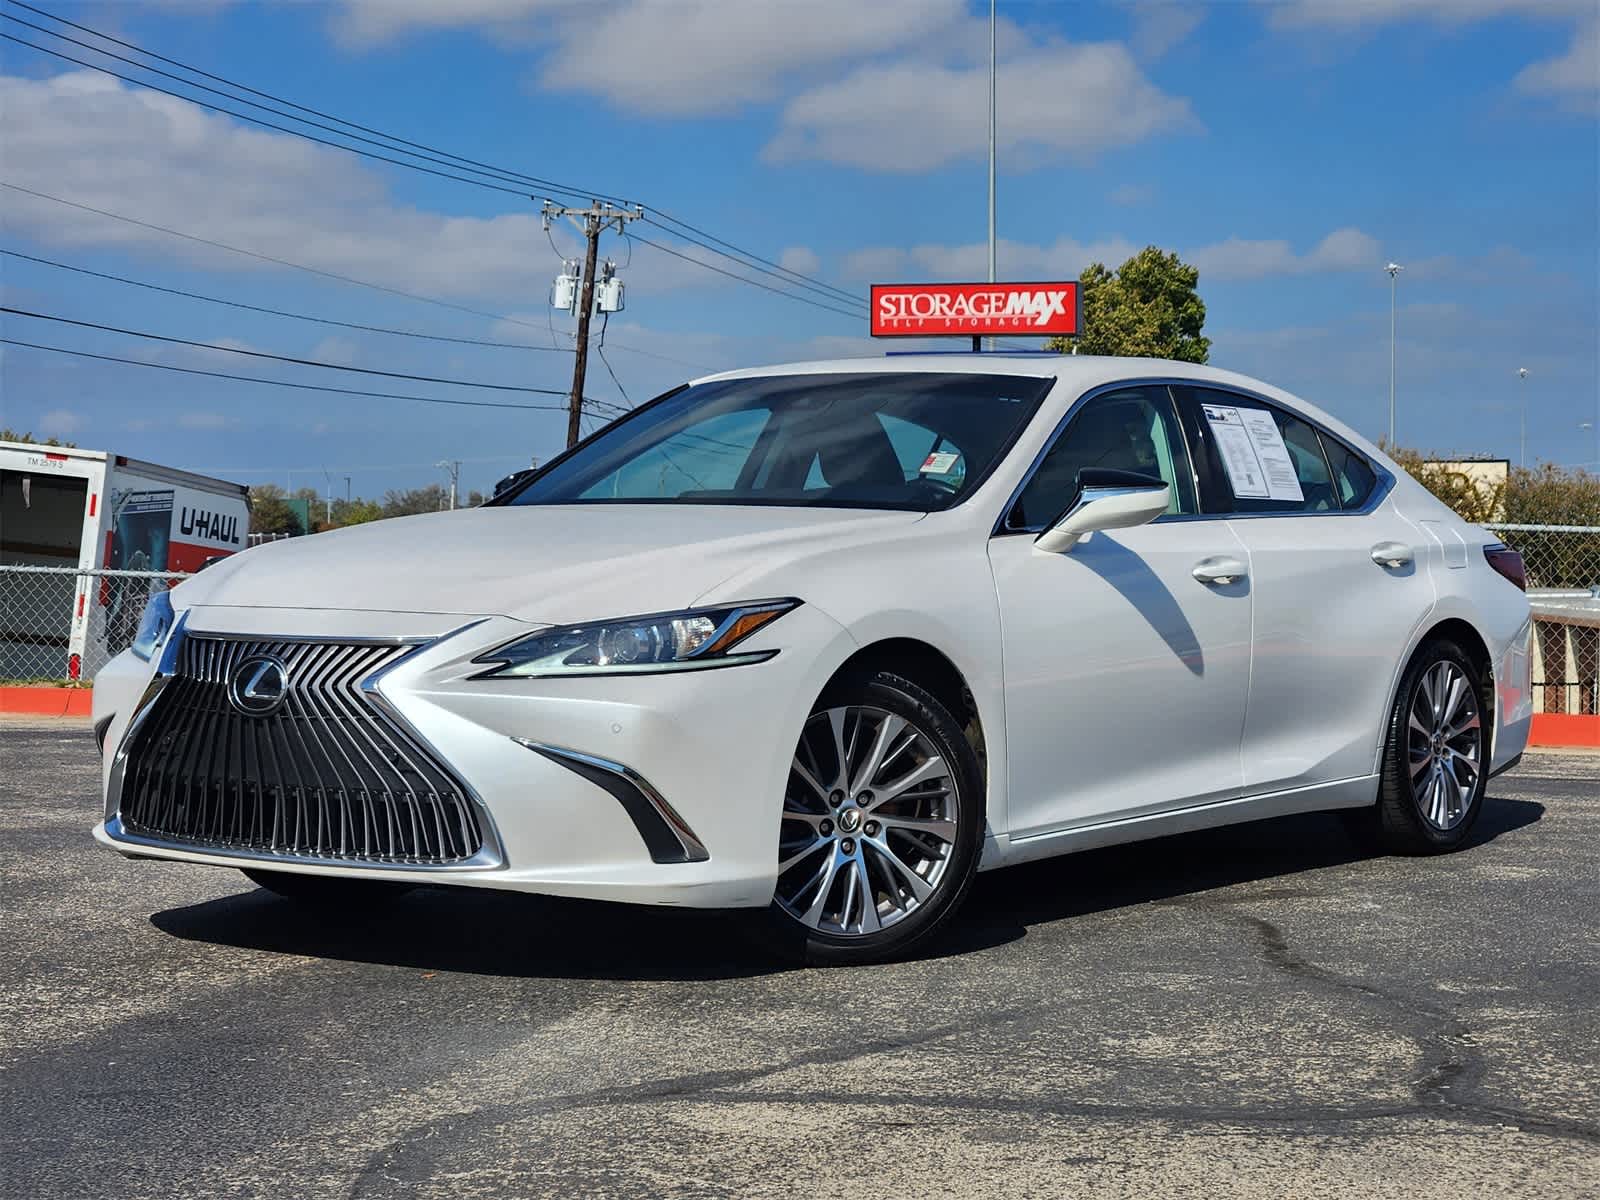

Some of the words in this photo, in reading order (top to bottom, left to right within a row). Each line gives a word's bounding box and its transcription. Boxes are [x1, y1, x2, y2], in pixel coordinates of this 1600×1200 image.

[880, 318, 924, 327] SELF
[944, 317, 1033, 327] STORAGE
[181, 506, 240, 544] U-HAUL
